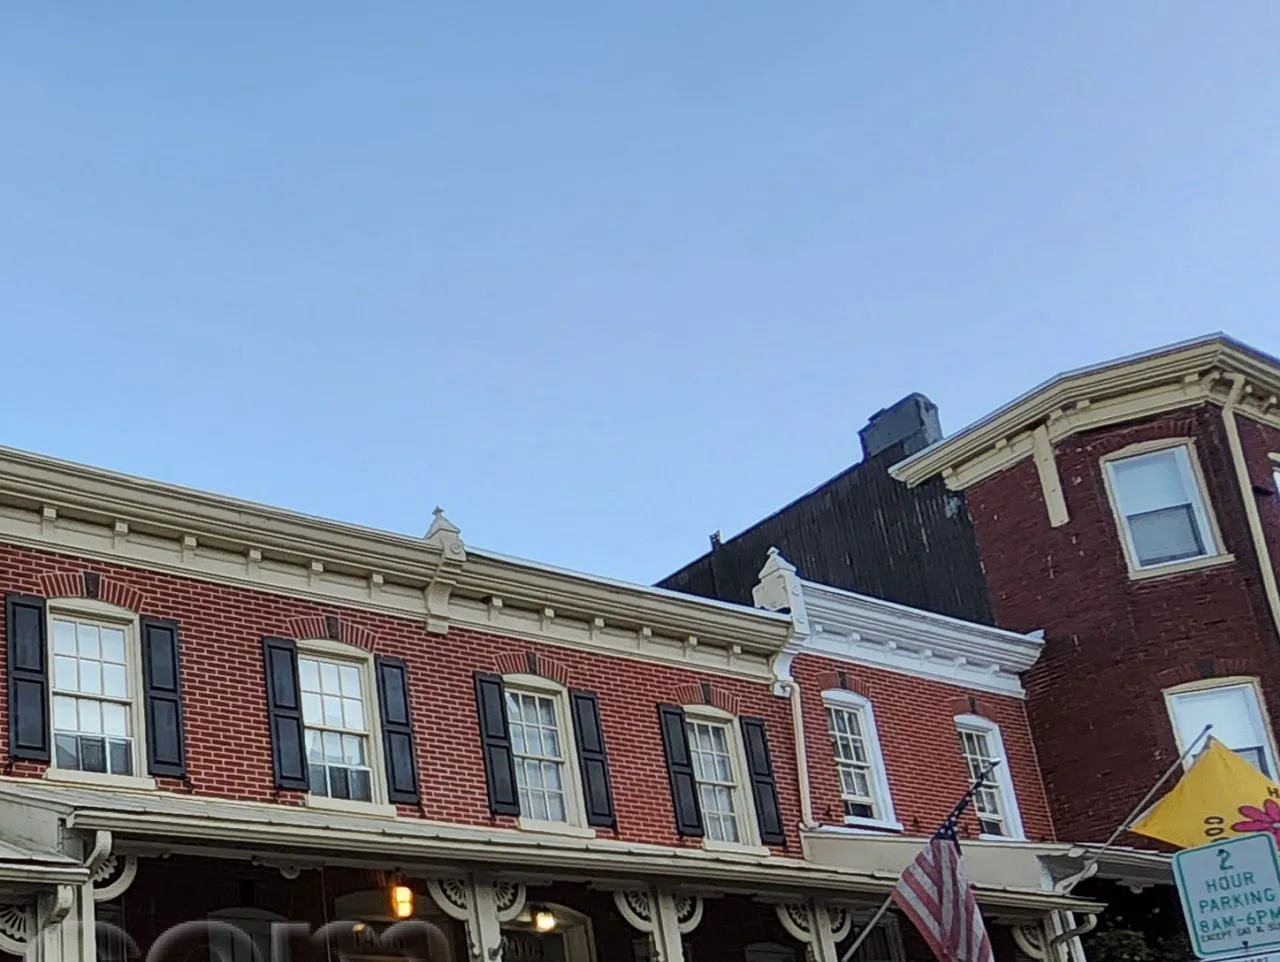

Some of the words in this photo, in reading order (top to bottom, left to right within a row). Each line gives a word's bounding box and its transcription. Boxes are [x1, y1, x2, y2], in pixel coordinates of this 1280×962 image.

[1216, 848, 1234, 871] 2
[1205, 871, 1256, 893] HOUR
[1198, 888, 1276, 914] PARKING
